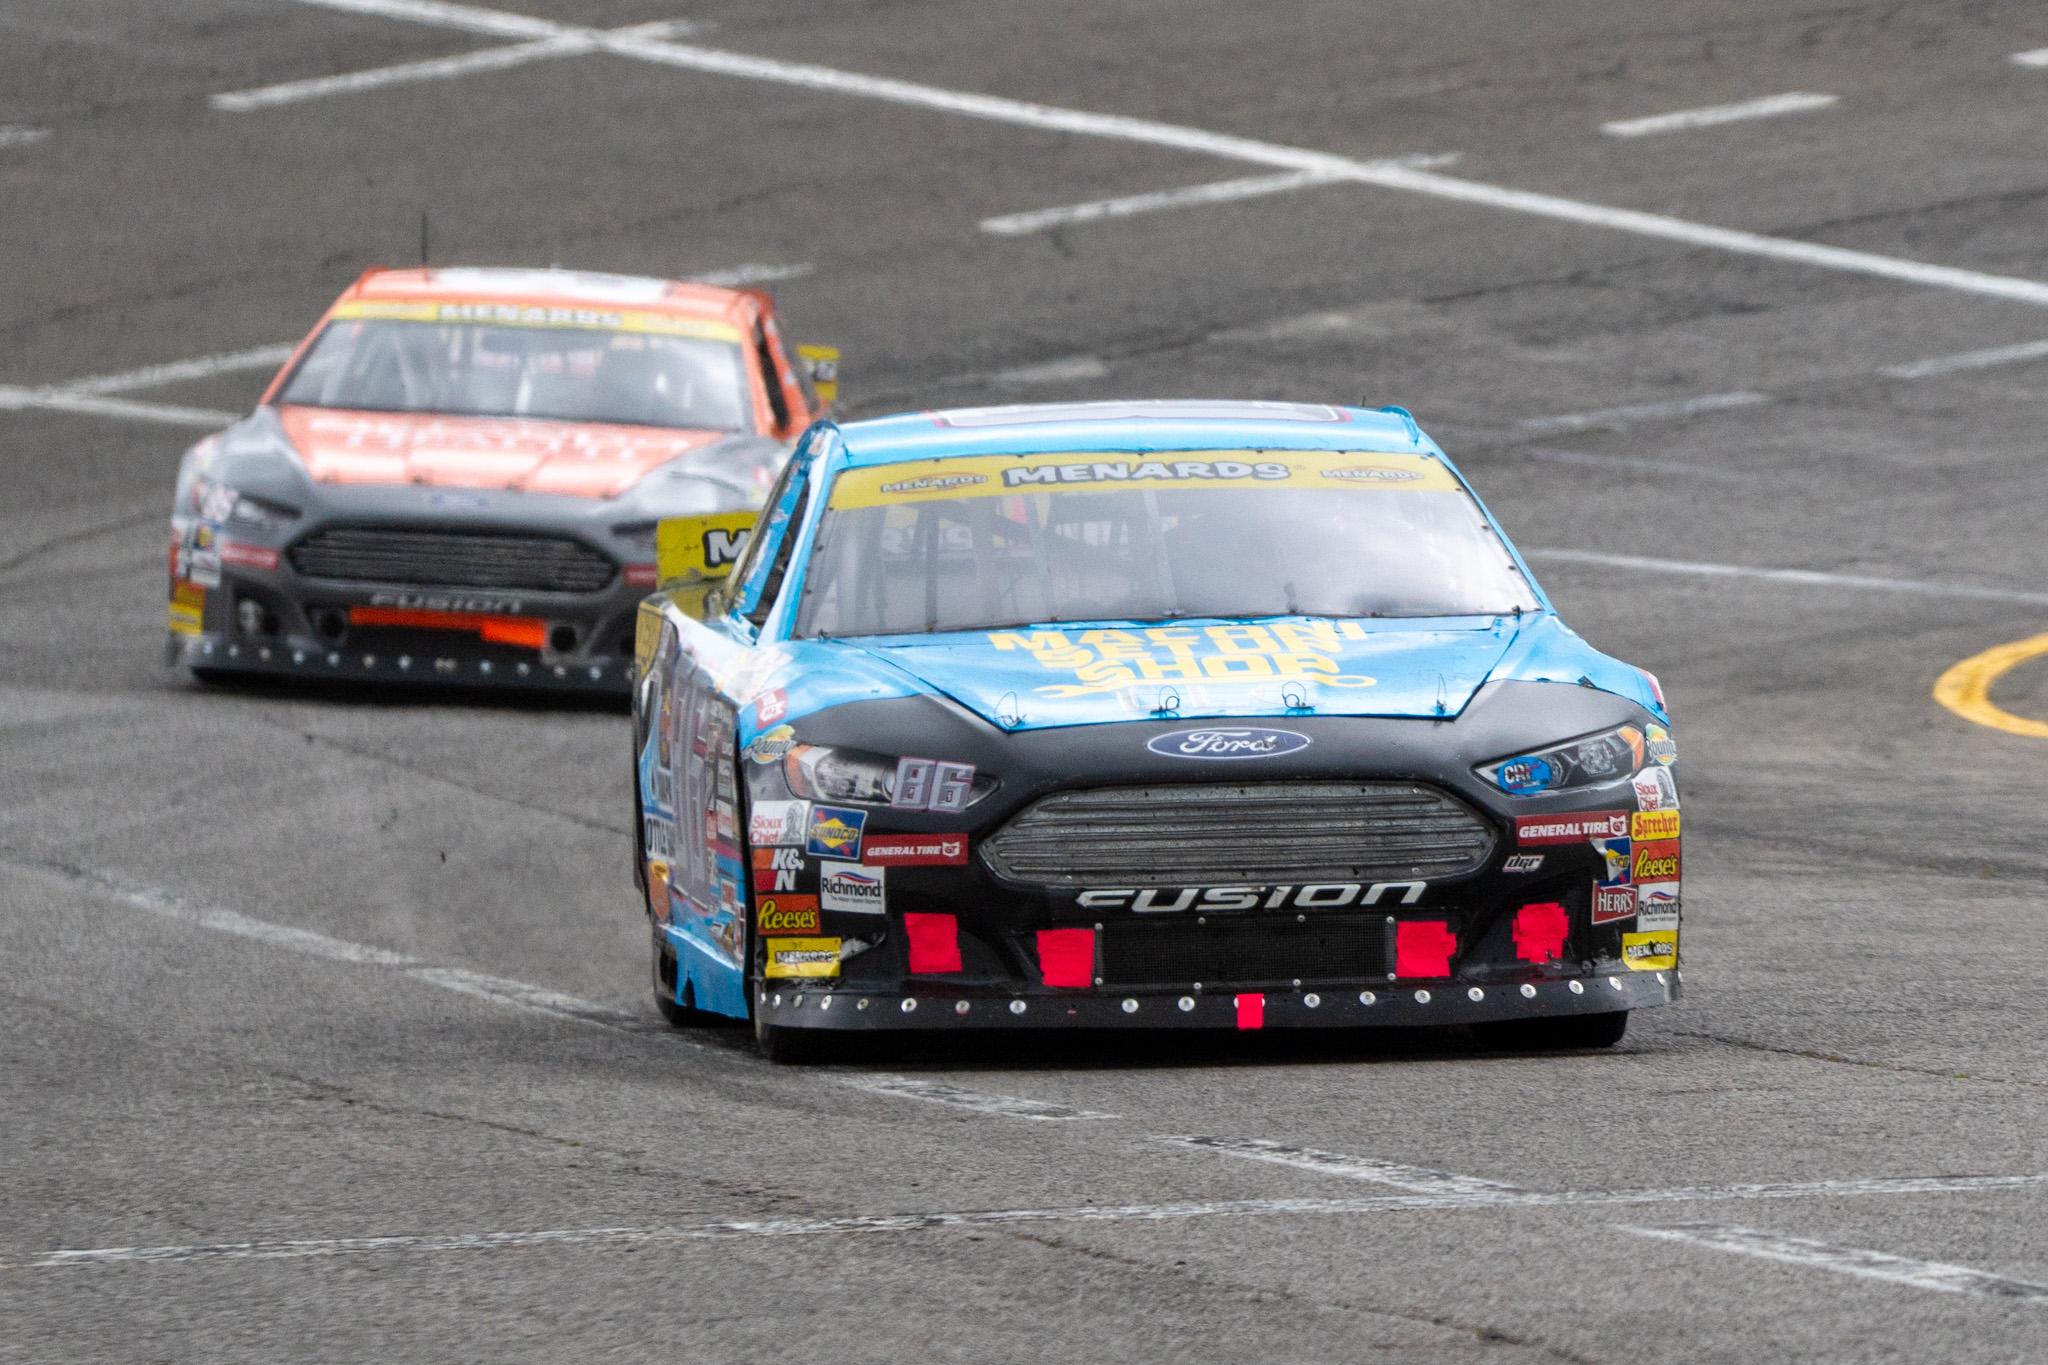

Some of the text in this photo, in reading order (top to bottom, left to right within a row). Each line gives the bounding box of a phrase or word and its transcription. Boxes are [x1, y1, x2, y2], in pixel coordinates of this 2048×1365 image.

[881, 474, 988, 493] MENARDS
[1002, 461, 1290, 487] MENARDS
[1320, 469, 1424, 481] MENARDS
[986, 622, 1369, 651] MACONI
[1077, 653, 1342, 681] SHOP
[1179, 731, 1277, 752] Ford
[891, 756, 976, 813] 86
[1635, 782, 1658, 795] Sioux
[753, 815, 783, 829] Sioux
[1519, 823, 1581, 838] GENERAL
[1582, 822, 1609, 834] TIRE
[1635, 814, 1678, 838] Sprecher
[750, 830, 780, 844] Chief
[809, 826, 858, 843] SUNOCO
[866, 846, 915, 857] GENERAL
[917, 846, 941, 855] TIRE
[1634, 849, 1678, 878] Reese's
[822, 877, 881, 897] Richmond
[1597, 891, 1633, 914] HERR'S
[1639, 901, 1678, 916] Richmond
[758, 900, 816, 929] Reese's
